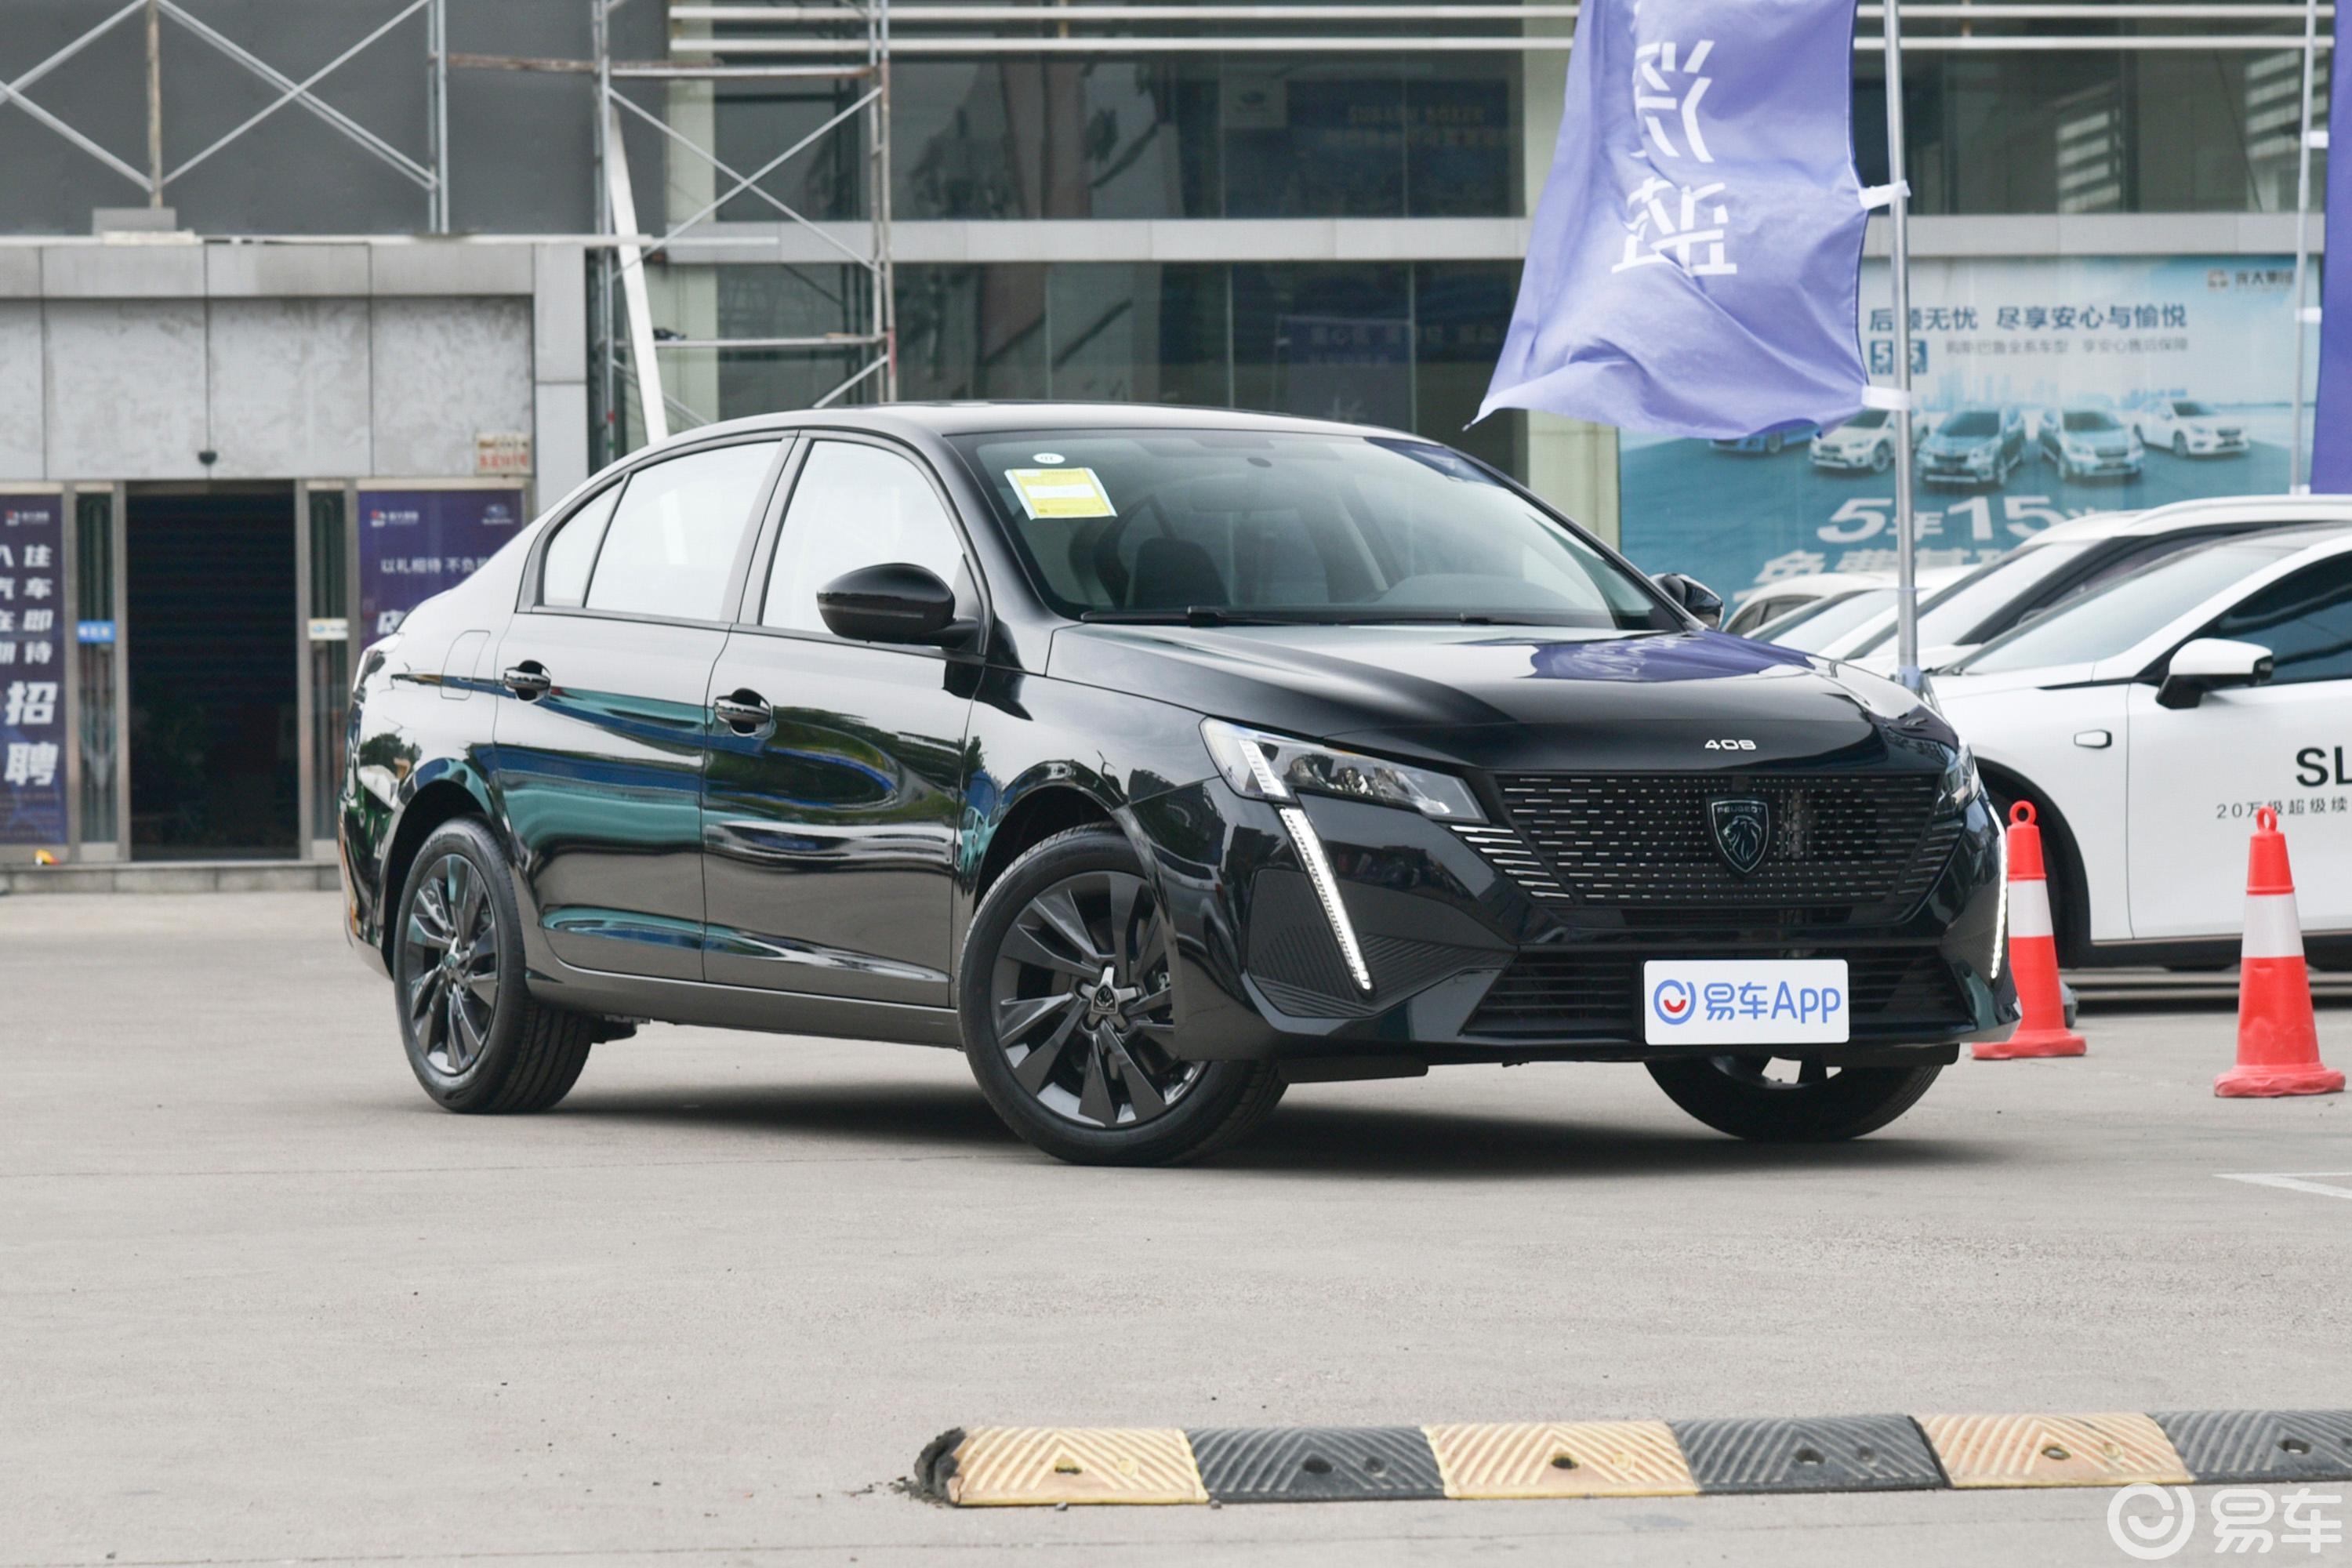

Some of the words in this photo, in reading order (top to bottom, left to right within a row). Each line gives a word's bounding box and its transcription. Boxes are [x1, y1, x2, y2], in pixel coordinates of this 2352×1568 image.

[1996, 303, 2187, 331] 尽享安心与愉悦
[1704, 739, 1757, 751] 408
[2296, 746, 2352, 788] SL
[1716, 805, 1763, 814] PEUGEOT
[1704, 981, 1842, 1024] 易车App
